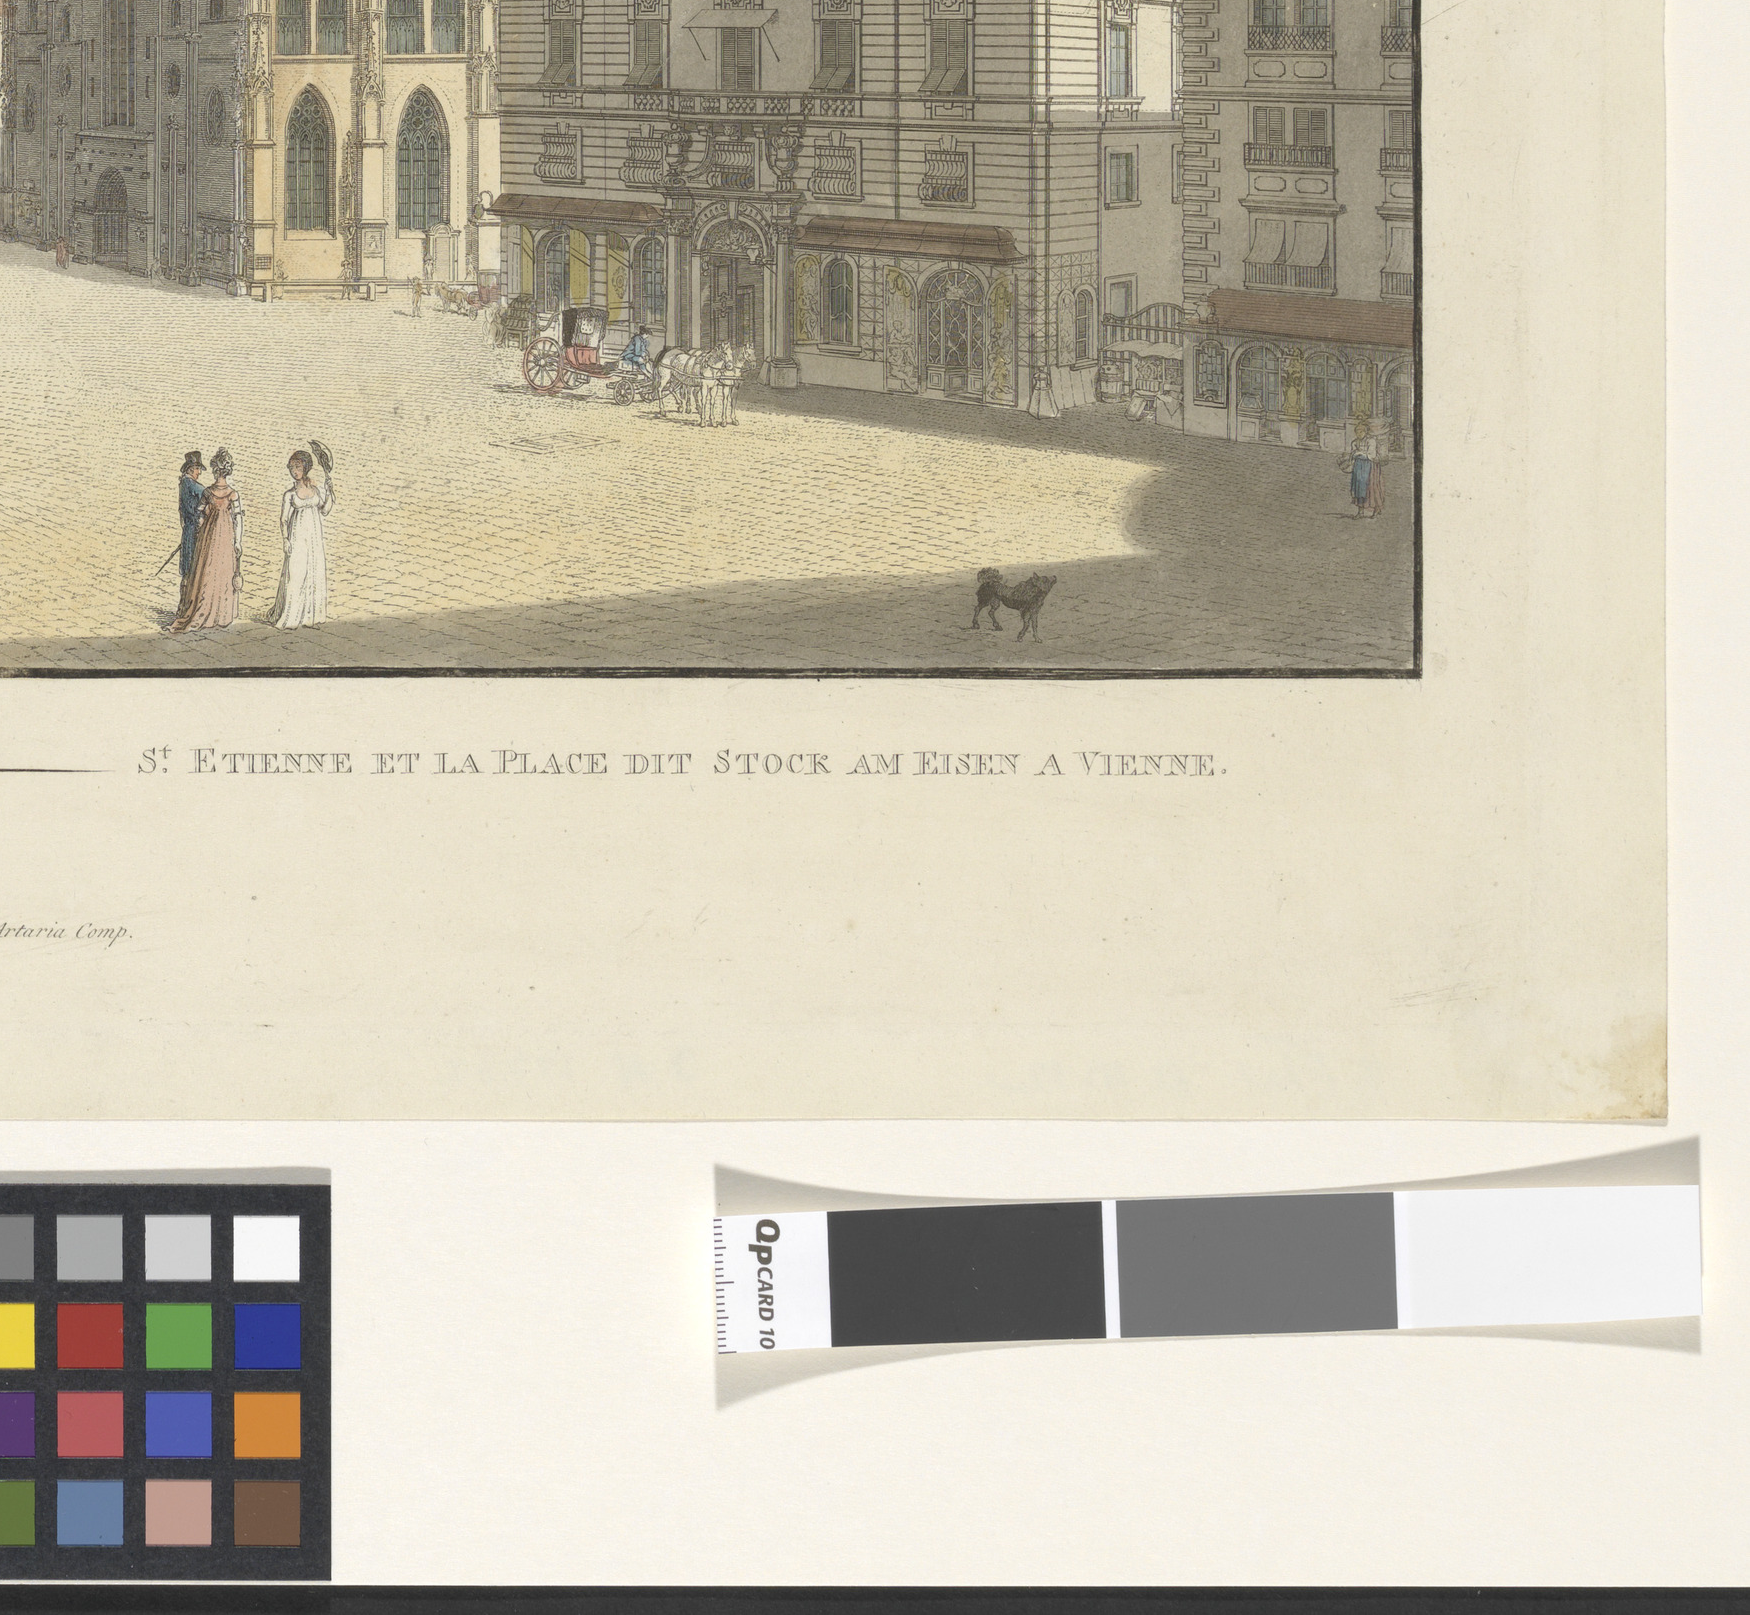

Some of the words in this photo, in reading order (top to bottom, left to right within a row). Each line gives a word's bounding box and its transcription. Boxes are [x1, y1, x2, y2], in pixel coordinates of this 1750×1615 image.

[187, 746, 353, 775] ETIENNE
[369, 751, 421, 775] ET
[433, 751, 485, 775] LA
[490, 748, 608, 775] PLACE
[622, 751, 693, 776] DIT
[713, 748, 832, 776] STOCK
[845, 752, 905, 776] AM
[911, 750, 1021, 776] EISEN
[1033, 752, 1066, 777] A
[1072, 750, 1228, 777] VIENNE.
[75, 921, 134, 948] Comp.
